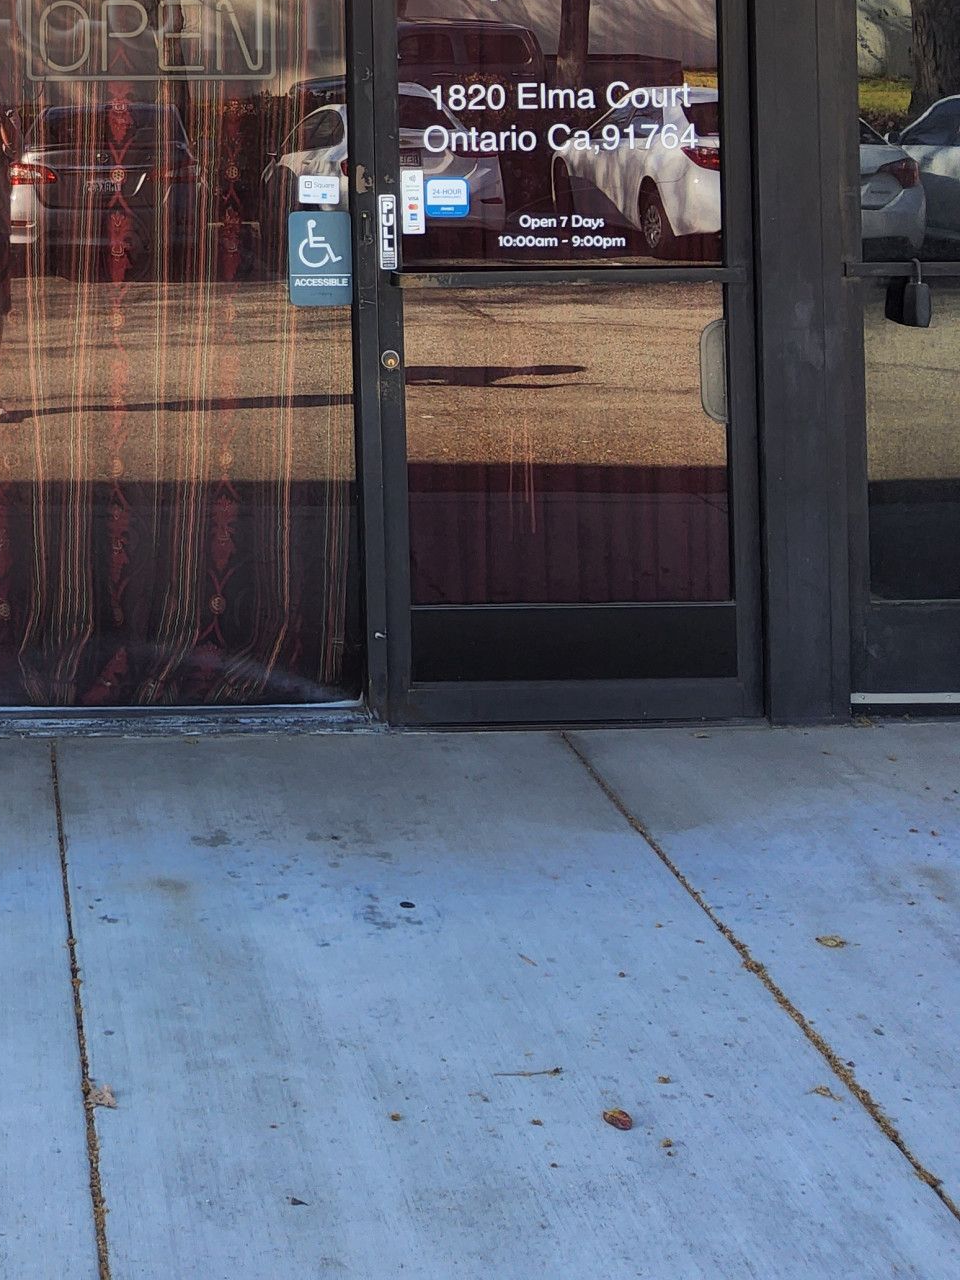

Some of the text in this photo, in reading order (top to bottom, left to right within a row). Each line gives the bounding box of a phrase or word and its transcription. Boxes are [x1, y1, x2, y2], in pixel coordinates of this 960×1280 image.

[39, 0, 264, 73] OPEN
[430, 80, 692, 111] 1820 Elma Court
[422, 123, 699, 155] Ontario Ca,91764
[382, 201, 394, 251] PULL
[519, 214, 605, 230] Open 7 Days
[497, 235, 559, 247] 10:00am
[571, 235, 626, 249] 9:00pm
[294, 278, 349, 287] ACCESSIBLE
